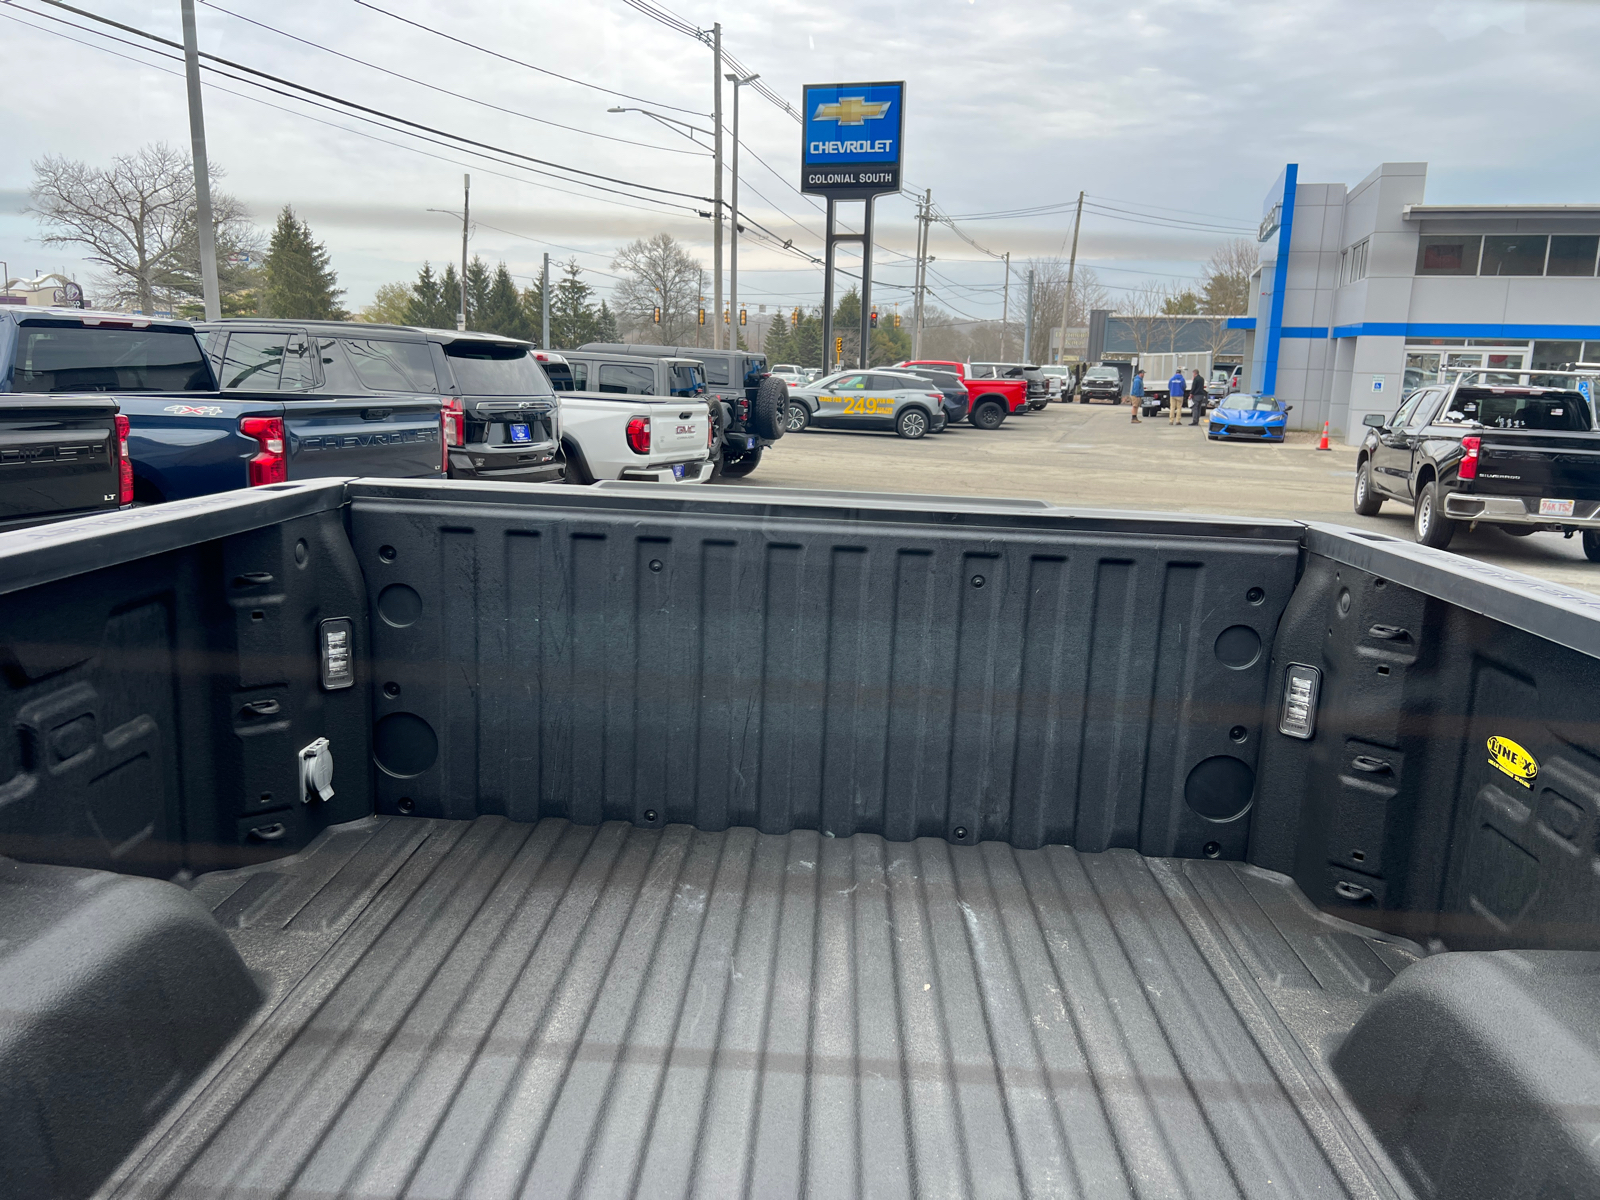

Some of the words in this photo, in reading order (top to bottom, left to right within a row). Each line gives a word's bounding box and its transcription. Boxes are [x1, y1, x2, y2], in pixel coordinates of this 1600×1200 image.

[810, 140, 893, 154] CHEVROLET
[808, 173, 856, 184] COLONIAL
[859, 172, 892, 183] SOUTH
[676, 425, 696, 434] GMC
[303, 430, 437, 452] CHEVROLET
[104, 493, 116, 501] LT
